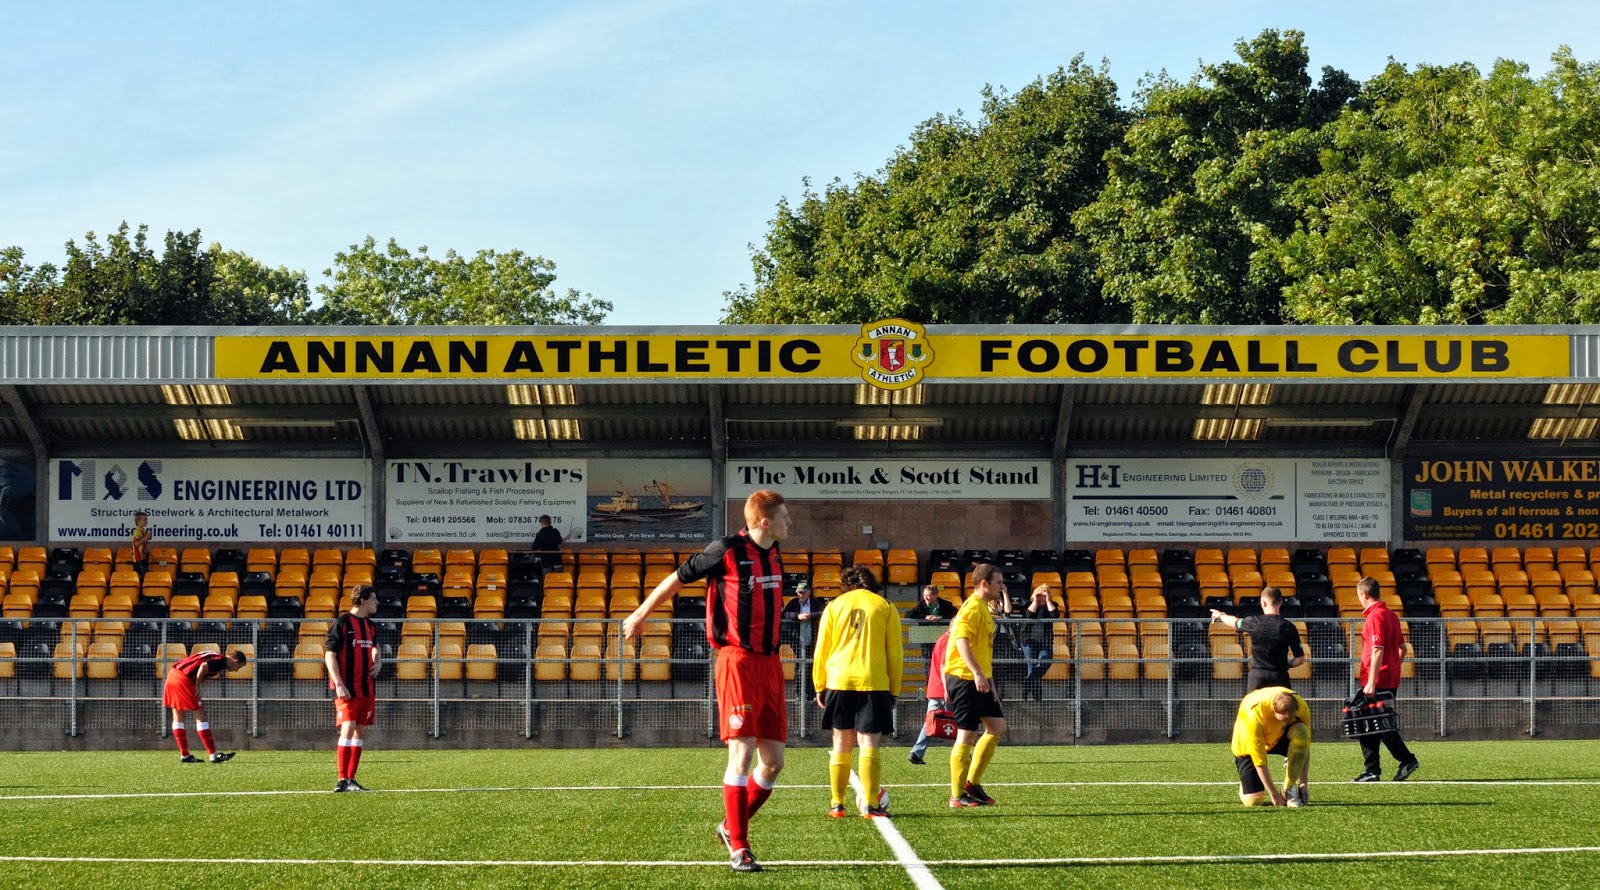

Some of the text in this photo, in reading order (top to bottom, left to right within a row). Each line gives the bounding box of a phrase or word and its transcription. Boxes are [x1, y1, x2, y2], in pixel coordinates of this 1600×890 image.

[876, 326, 910, 337] ANNAN
[260, 340, 1511, 374] ANNAN ATHLETIC FOOTBALL CLUB
[870, 370, 915, 382] ATHLETIC
[738, 466, 1039, 484] The Monk & Scott Stand
[1415, 460, 1600, 482] JOHN WALKE
[1123, 473, 1186, 482] ENGINEERING
[1189, 473, 1227, 481] LIMITED
[174, 480, 318, 501] ENGINEERING
[325, 480, 362, 500] LTD
[1471, 490, 1505, 499] Metal
[1510, 490, 1569, 501] recyclers
[1574, 489, 1583, 499] &
[144, 508, 195, 517] Steelwork
[198, 508, 205, 517] &
[207, 508, 273, 517] Architectural
[276, 508, 330, 517] Metalwork
[1083, 506, 1276, 516] Tel: 01461 40500 Fax: 01461 40801
[1444, 506, 1599, 518] Buyers of all ferrous & non
[259, 524, 281, 537] Tel:
[286, 524, 321, 537] 01461
[327, 524, 362, 537] 40111
[1494, 523, 1600, 538] 01461 202
[850, 608, 866, 639] 9
